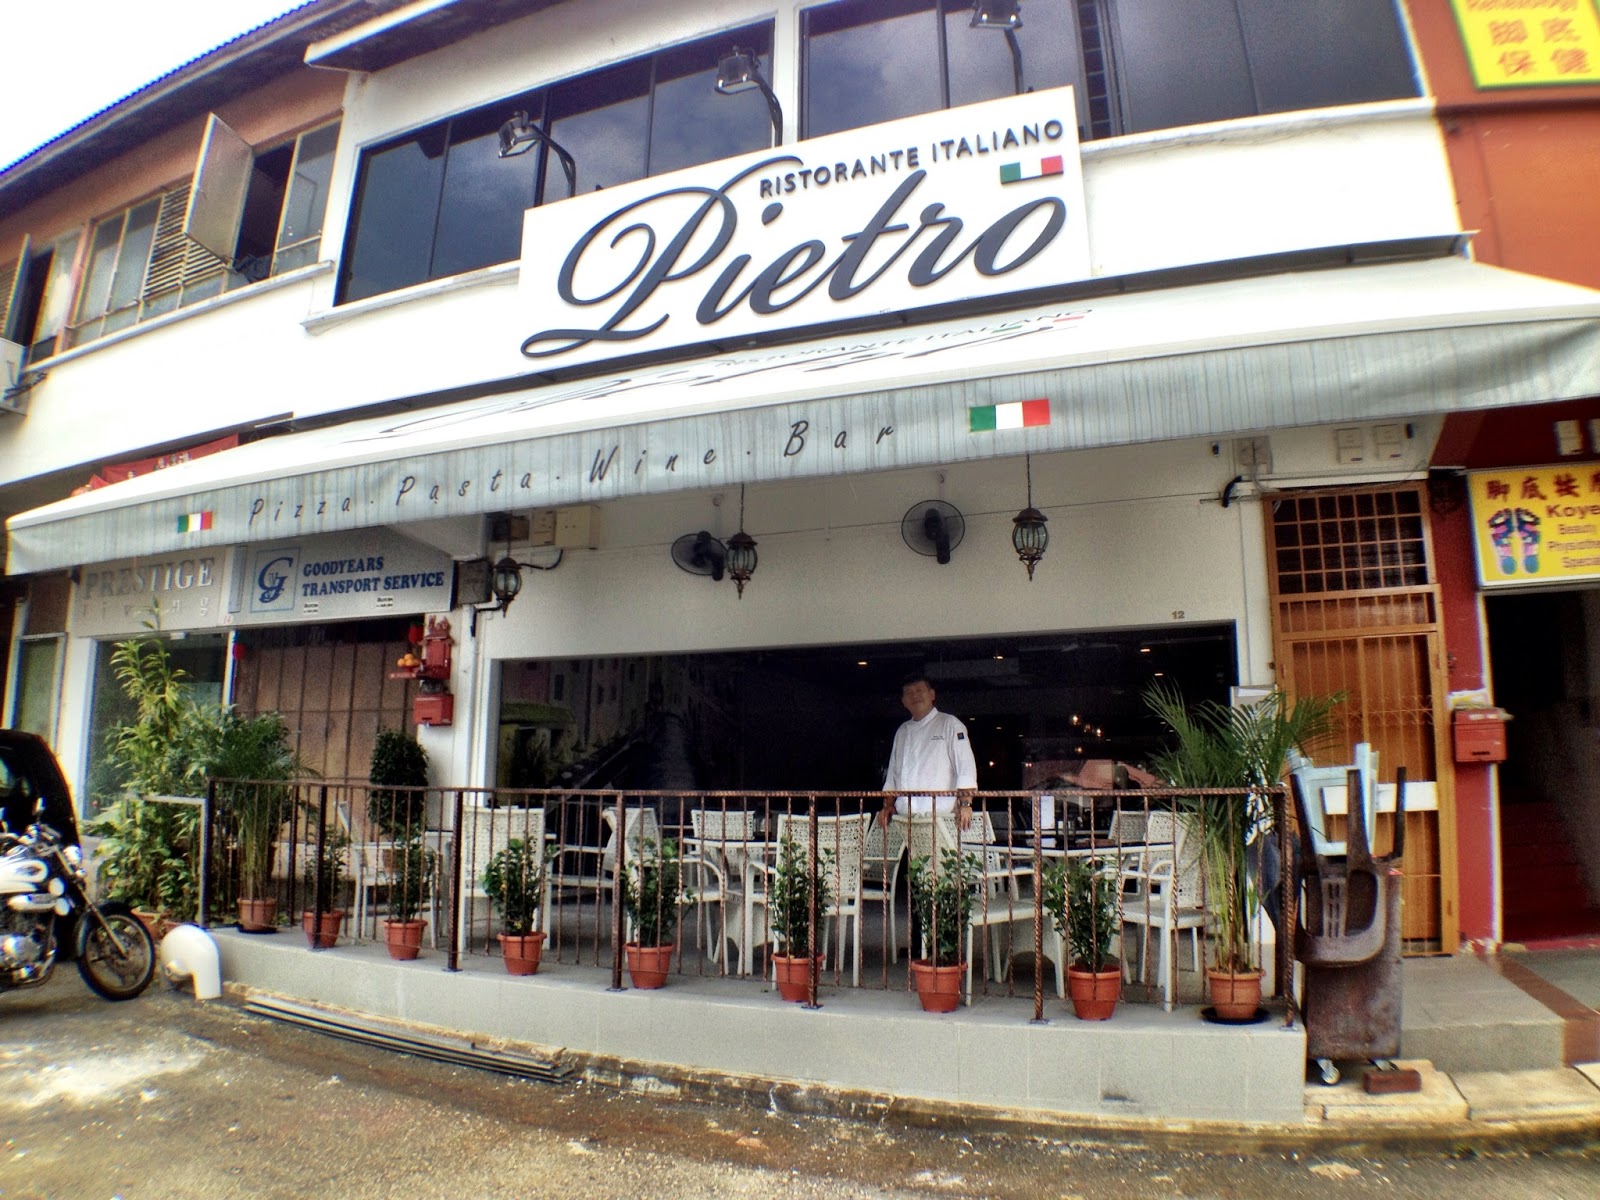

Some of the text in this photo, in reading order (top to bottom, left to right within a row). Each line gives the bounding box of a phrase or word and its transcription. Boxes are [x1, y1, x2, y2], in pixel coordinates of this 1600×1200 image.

[760, 119, 1064, 198] RISTORANTE ITALIANO
[520, 155, 1066, 358] Pietro
[783, 420, 894, 457] Bar
[84, 557, 215, 599] PRESTIGE
[302, 572, 445, 597] TRANSPORT SERVICE
[303, 556, 384, 577] GOODYEARS
[1172, 610, 1185, 620] 12
